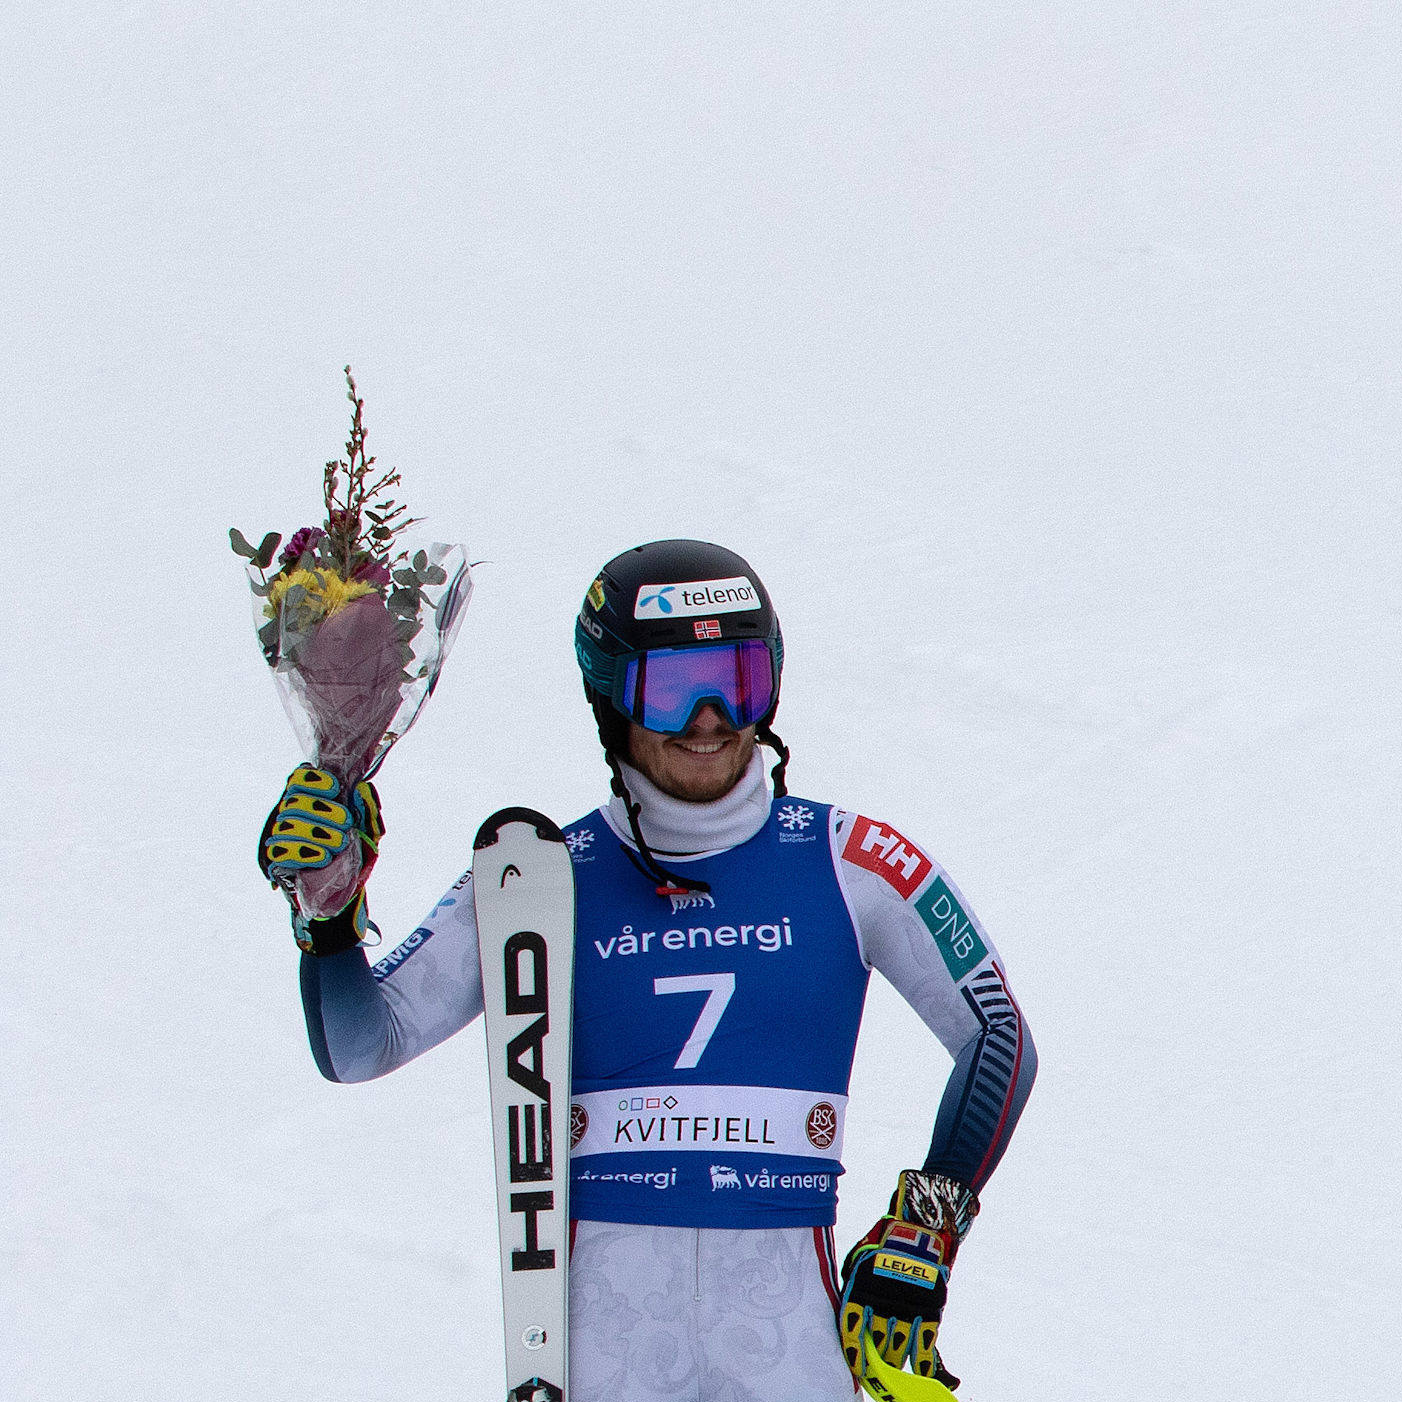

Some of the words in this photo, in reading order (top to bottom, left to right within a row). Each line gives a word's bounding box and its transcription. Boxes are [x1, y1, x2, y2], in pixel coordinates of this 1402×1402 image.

[682, 586, 754, 607] telenor
[860, 824, 922, 881] HH
[594, 925, 656, 959] vår
[662, 917, 793, 952] energi
[931, 894, 974, 959] DNB
[654, 972, 736, 1069] 7
[504, 930, 556, 1272] HEAD
[614, 1117, 776, 1145] KVITFJELL
[745, 1169, 775, 1188] vår
[882, 1258, 929, 1279] LEVEL
